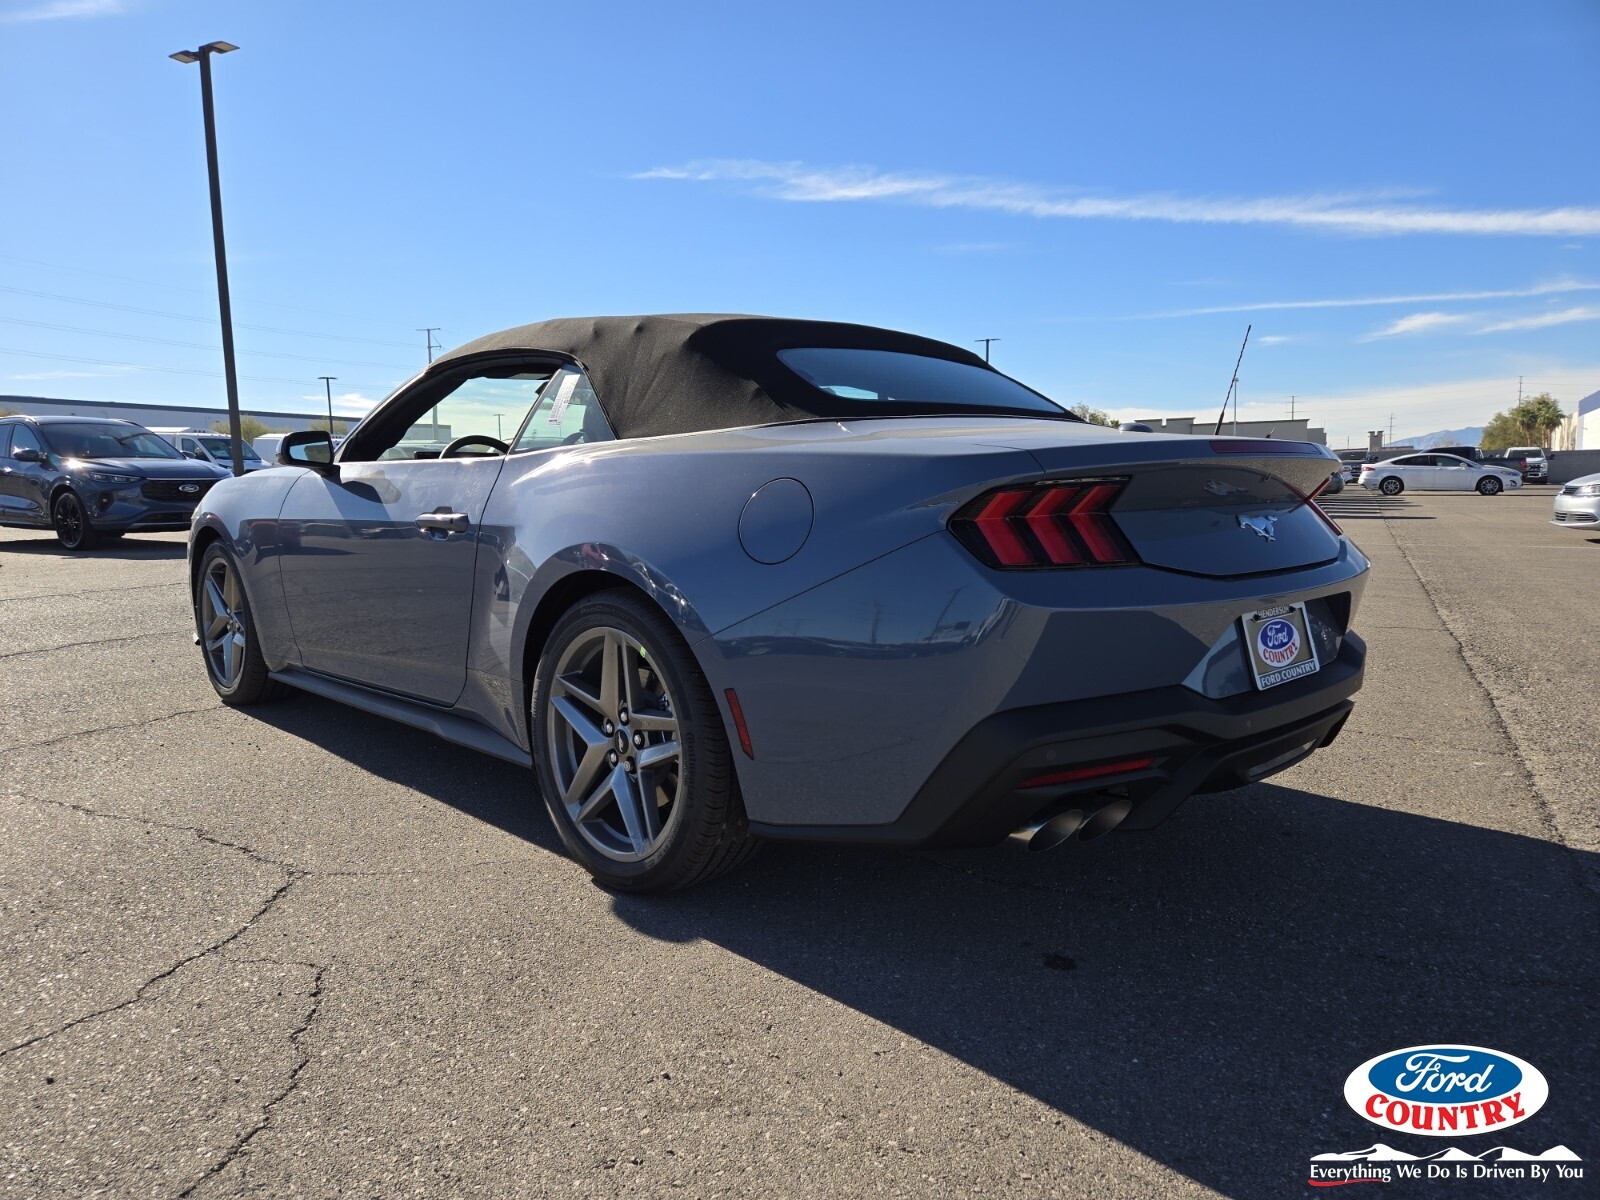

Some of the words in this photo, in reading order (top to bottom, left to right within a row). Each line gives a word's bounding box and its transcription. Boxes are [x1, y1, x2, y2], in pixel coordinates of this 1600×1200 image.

[1259, 606, 1289, 618] HENDERSON
[1267, 624, 1288, 647] Ford
[1263, 640, 1298, 663] COUNTRY
[1261, 674, 1281, 687] FORD
[1281, 663, 1315, 680] COUNTRY
